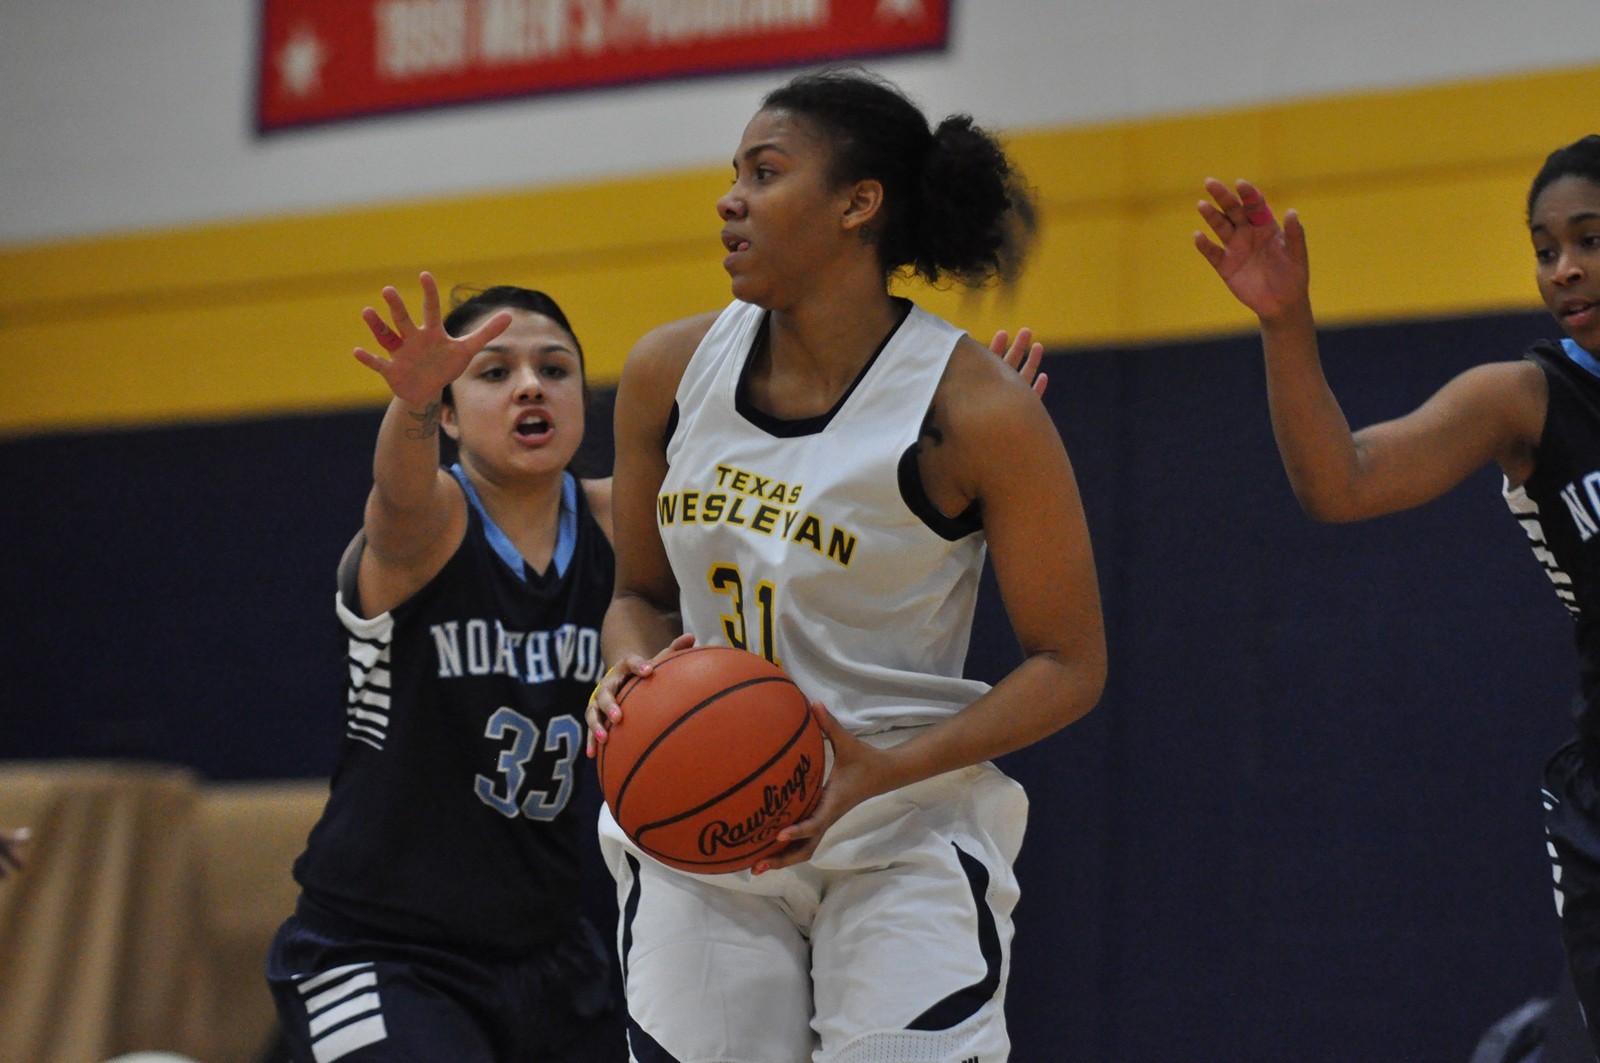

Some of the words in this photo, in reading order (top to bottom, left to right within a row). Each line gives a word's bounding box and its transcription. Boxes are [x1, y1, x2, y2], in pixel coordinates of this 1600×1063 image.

[656, 490, 860, 570] WESLEYAN
[715, 463, 804, 507] TEXAS
[707, 561, 782, 670] 31
[473, 706, 582, 822] 33
[698, 753, 811, 857] Rawlings
